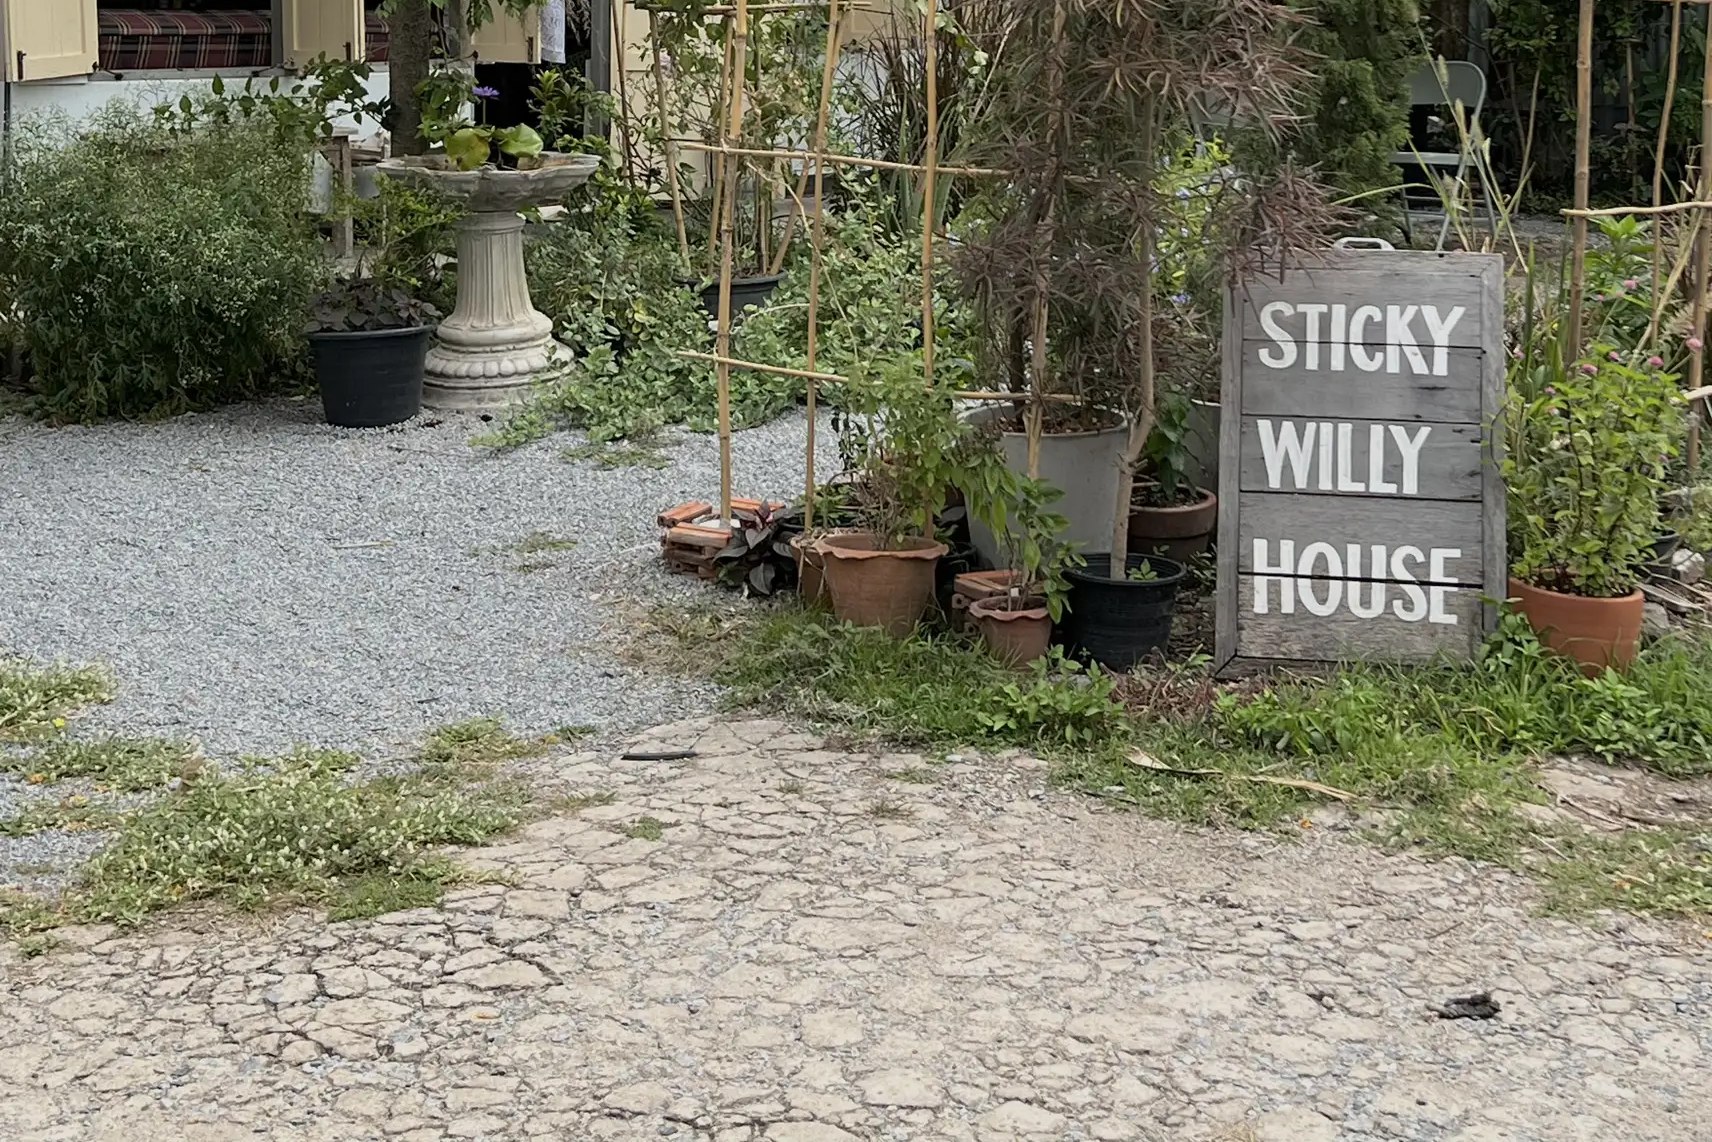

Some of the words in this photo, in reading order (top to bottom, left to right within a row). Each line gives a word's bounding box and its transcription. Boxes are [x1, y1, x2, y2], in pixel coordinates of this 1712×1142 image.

[1258, 301, 1467, 376] STICKY
[1256, 419, 1433, 495] WILLY
[1252, 538, 1462, 625] HOUSE
